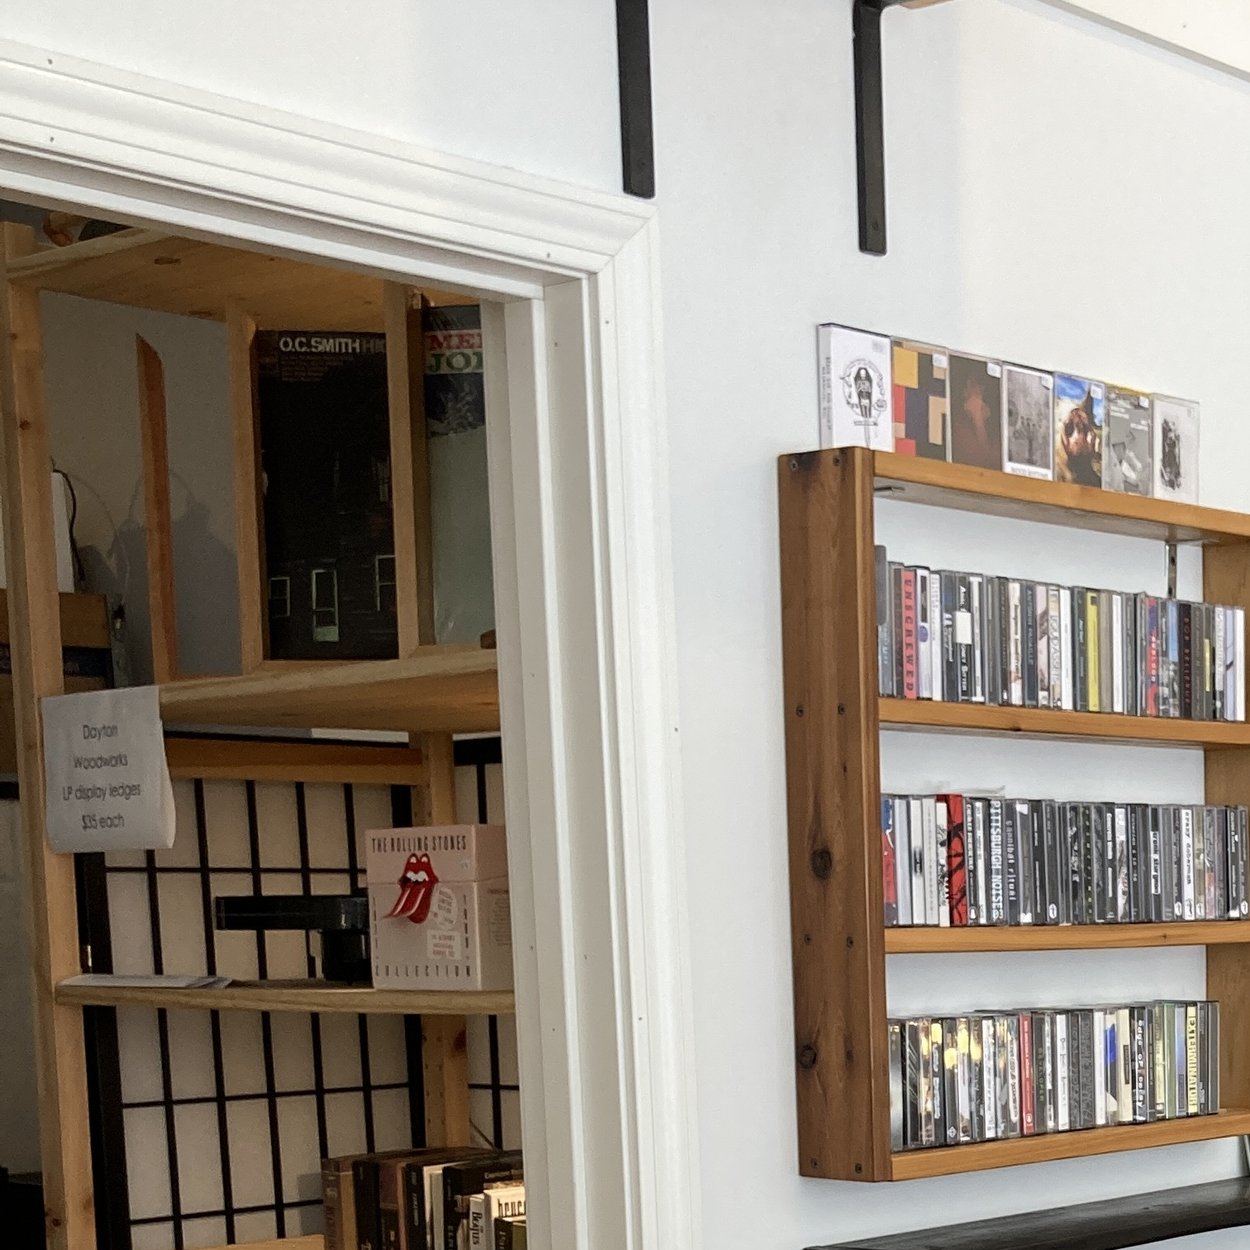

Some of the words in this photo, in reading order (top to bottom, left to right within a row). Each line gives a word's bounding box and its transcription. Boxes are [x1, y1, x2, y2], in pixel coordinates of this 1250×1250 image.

[311, 337, 360, 353] SMITH
[427, 333, 483, 350] ME
[903, 579, 915, 693] UNSCREWED
[82, 723, 118, 741] Dayton
[73, 753, 128, 770] Woodworks
[62, 786, 73, 801] LP
[75, 784, 107, 802] display
[109, 783, 142, 800] ledges
[99, 812, 125, 829] each
[372, 837, 387, 853] THE
[390, 835, 429, 852] ROLLING
[432, 834, 467, 851] STONES
[990, 800, 1002, 868] PITTSBURGH
[992, 875, 1003, 911] NOISE
[375, 964, 471, 978] COLLECTION
[1188, 1017, 1197, 1105] EXTERMINATOR
[468, 1210, 484, 1246] BEATLES
